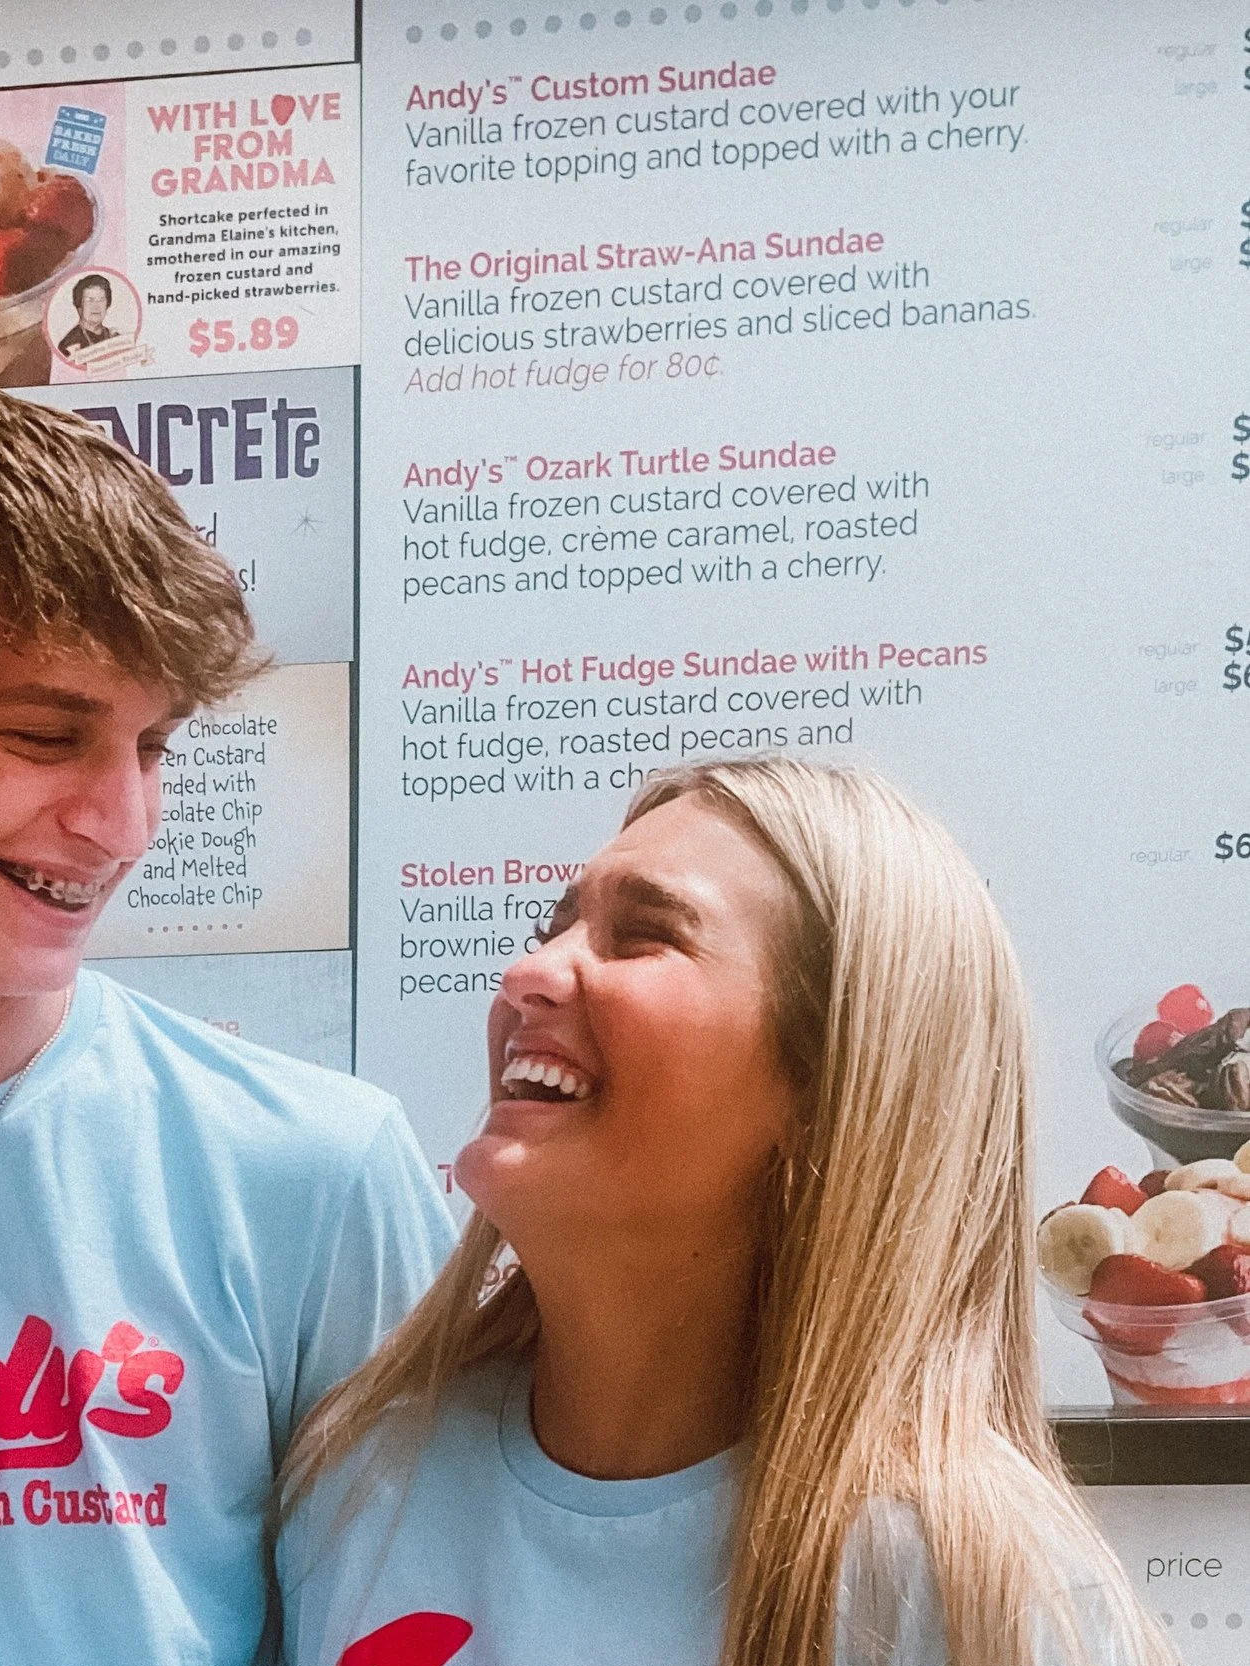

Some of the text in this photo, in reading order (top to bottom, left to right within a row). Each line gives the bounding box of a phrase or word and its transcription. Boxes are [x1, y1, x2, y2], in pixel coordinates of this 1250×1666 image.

[531, 72, 648, 101] Custom
[658, 61, 776, 93] Sundae
[147, 100, 236, 133] WITH
[406, 85, 1020, 148] Vanilla frozen custard covered with your
[194, 129, 292, 162] FROM
[406, 121, 1030, 186] favorite topping and topped with cherry.
[151, 157, 335, 197] GRANDMA
[159, 204, 328, 227] Shortcake perfected in
[149, 224, 338, 247] Grandma Elaine's kitchen,
[147, 243, 340, 266] smothered in our amazing
[405, 228, 884, 283] The Original Straw-Ana Sundae
[174, 262, 313, 283] frozen custard and
[147, 281, 340, 304] hand-picked strawberries.
[405, 261, 929, 319] Vanilla frozen custard covered with
[188, 315, 299, 358] $5.89
[404, 299, 1036, 357] delicious strawberries and sliced bananas.
[404, 364, 464, 394] Add
[471, 362, 517, 389] hot
[526, 357, 609, 392] fudge
[618, 353, 658, 381] for
[526, 452, 611, 481] Ozark
[620, 447, 709, 476] Turtle
[719, 441, 836, 471] Sundae
[404, 509, 917, 563] hot fudge, crème caramel, roasted
[404, 551, 887, 604] pecans and topped with cherry.
[523, 658, 573, 683] Hot
[582, 654, 675, 686] Fudge
[683, 649, 797, 677] Sundae
[805, 644, 868, 672] with
[879, 643, 987, 669] Pecans
[188, 714, 277, 738] Chocolate
[403, 717, 853, 764] hot fudge, roasted pecans and
[193, 742, 265, 766] Custard
[213, 770, 256, 793] with
[402, 765, 573, 802] topped with
[222, 798, 262, 825] Chip
[202, 827, 256, 855] Dough
[143, 854, 247, 881] and Melted
[401, 861, 494, 887] Stolen
[127, 882, 262, 909] Chocolate Chip
[400, 896, 493, 923] Vanilla
[401, 930, 514, 959] brownie
[400, 970, 502, 1001] pecans
[23, 1479, 167, 1527] Custard
[1147, 1552, 1222, 1583] price
